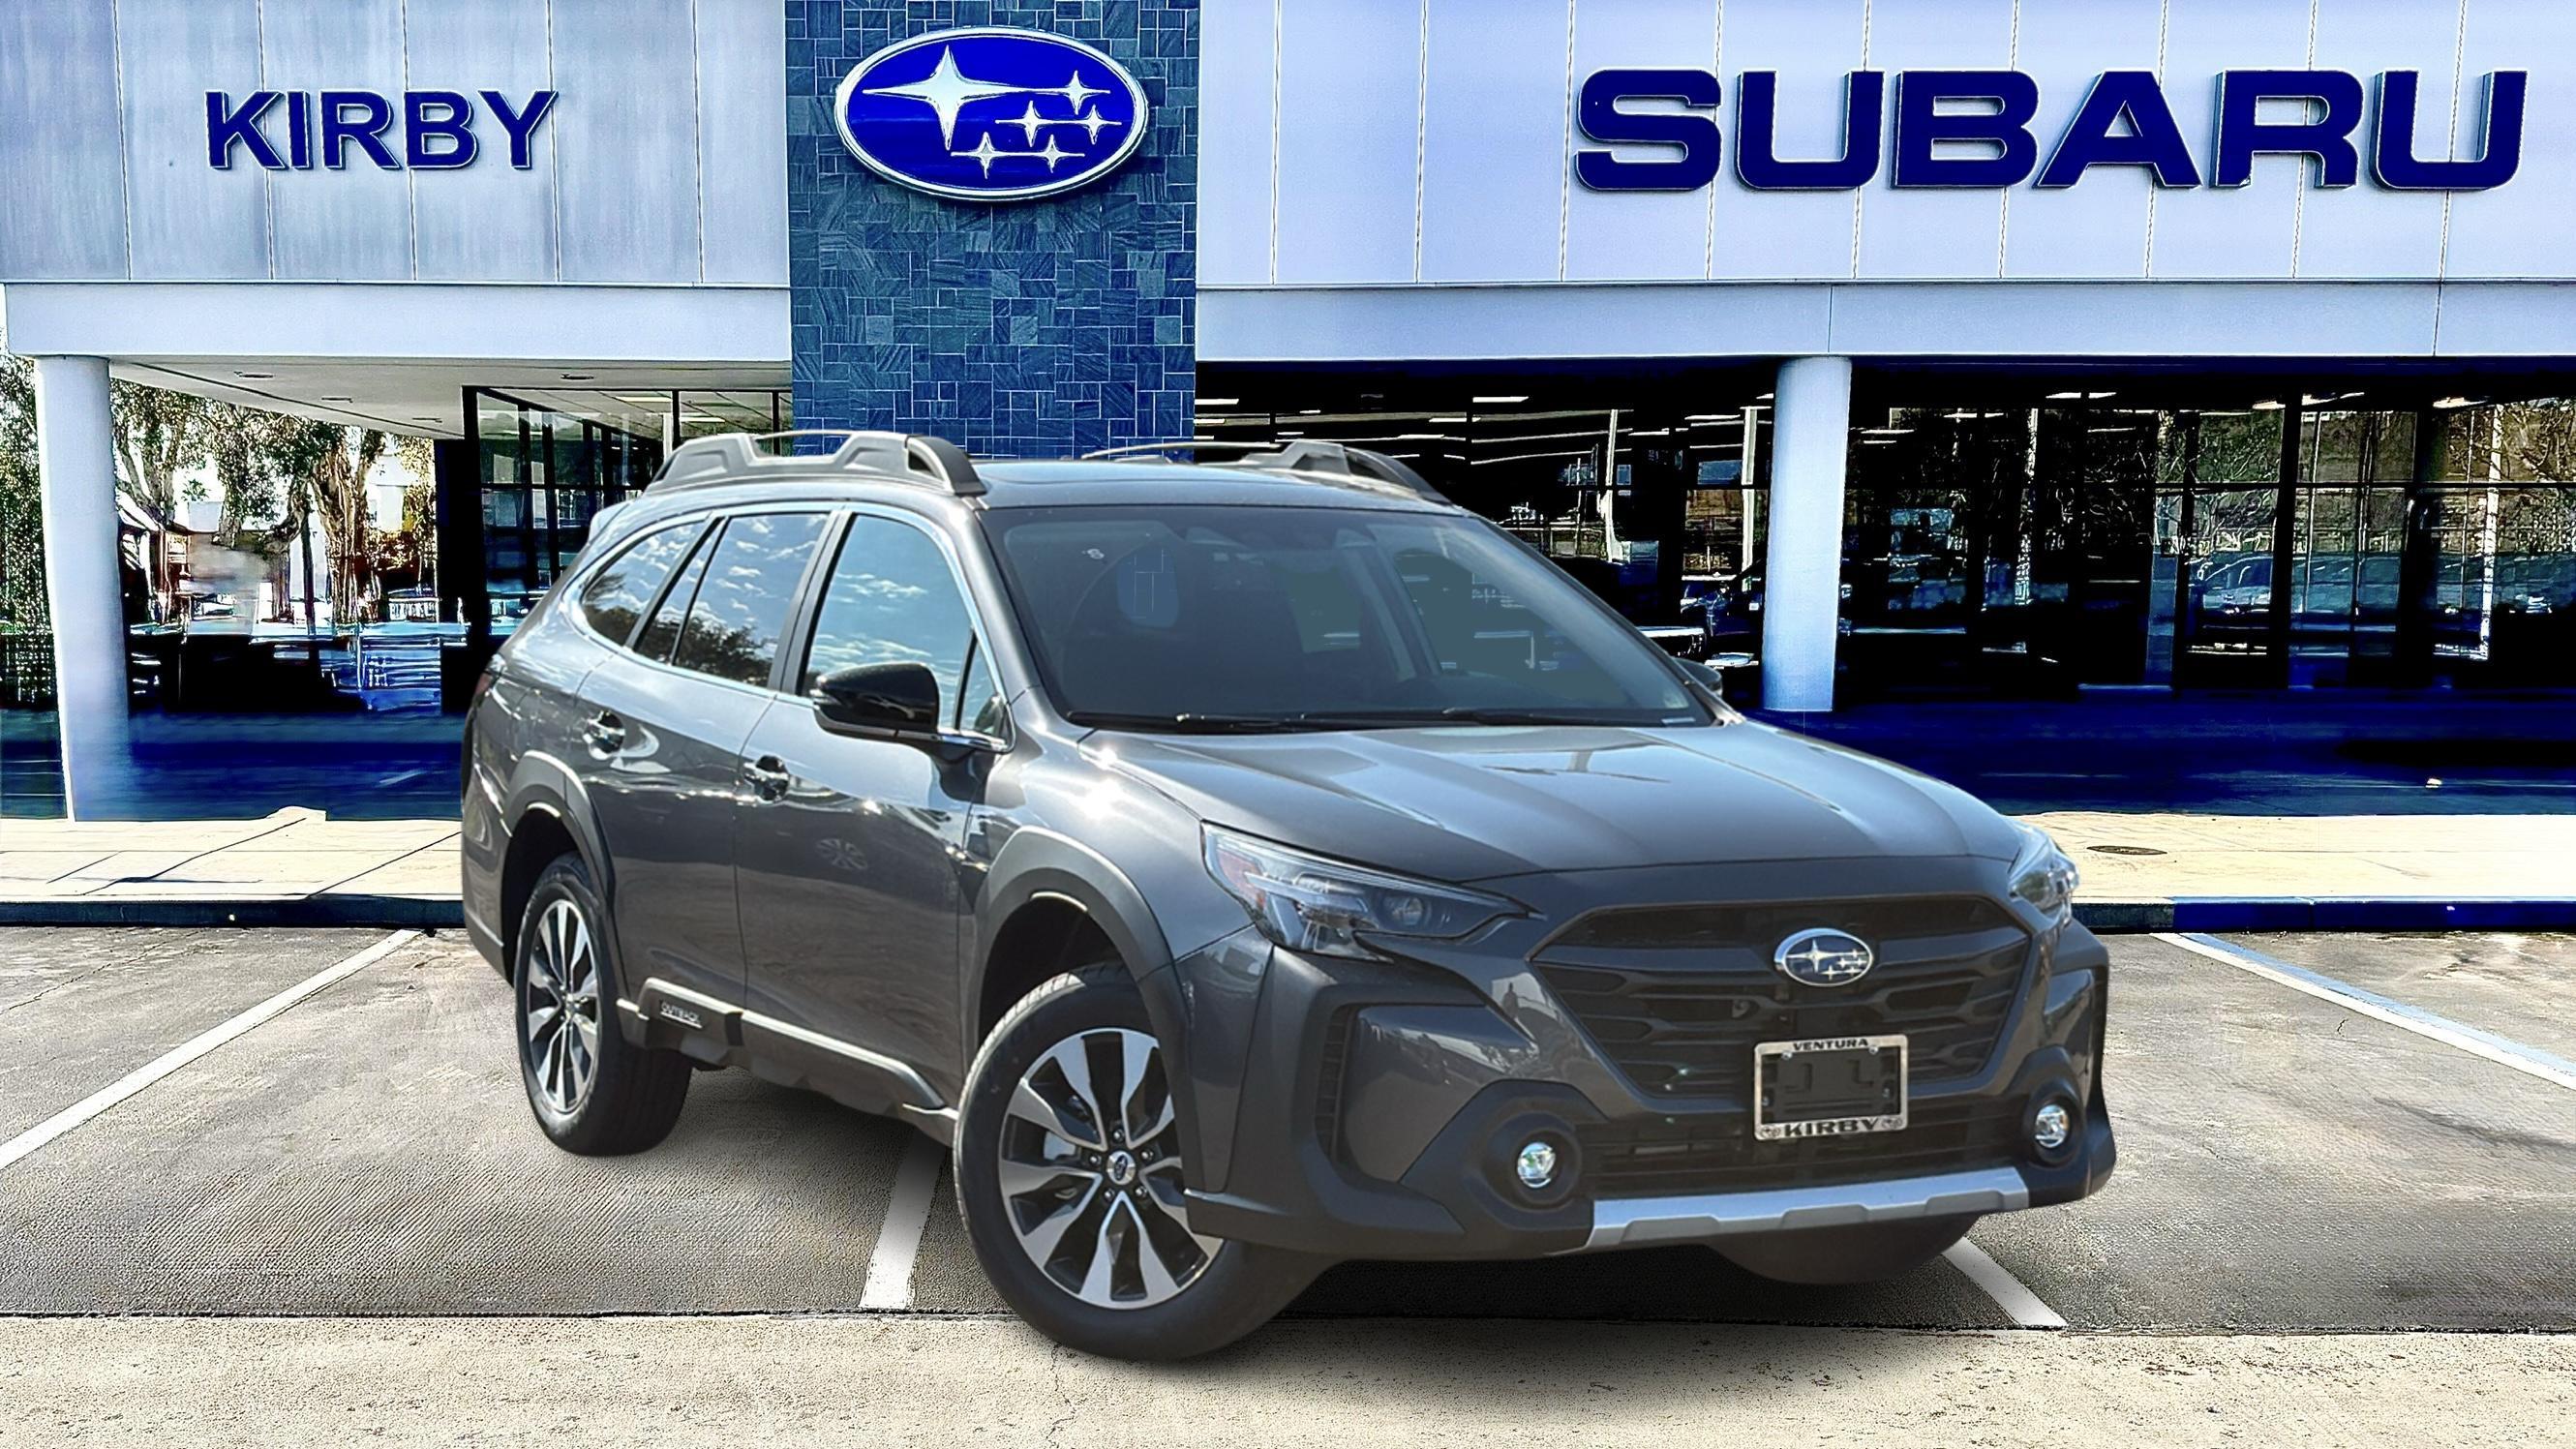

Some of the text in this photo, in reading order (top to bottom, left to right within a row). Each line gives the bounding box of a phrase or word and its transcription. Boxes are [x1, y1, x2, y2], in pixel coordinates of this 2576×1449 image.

[204, 90, 560, 170] KIRBY
[1576, 68, 2530, 192] SUBARU
[1793, 1038, 1869, 1052] VENTURA
[1783, 1117, 1880, 1137] KIRBY
